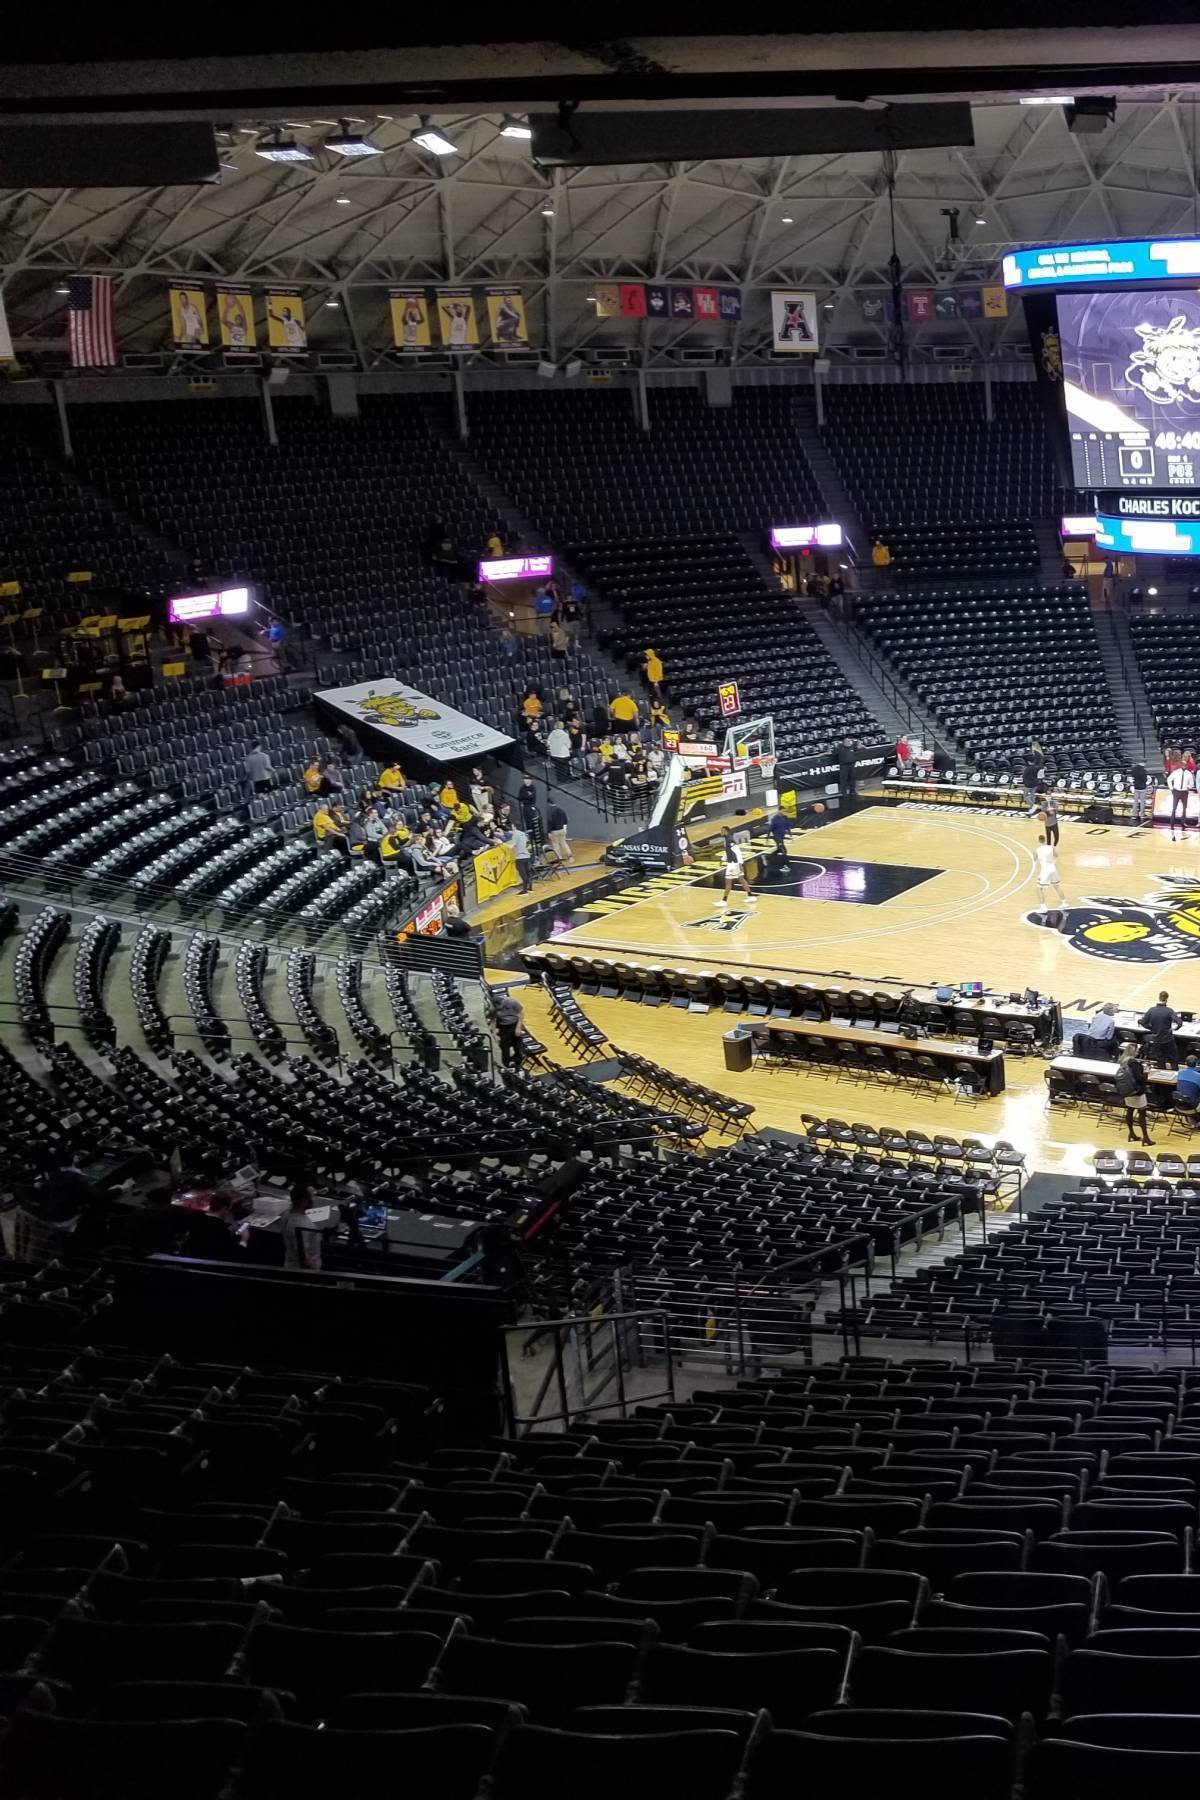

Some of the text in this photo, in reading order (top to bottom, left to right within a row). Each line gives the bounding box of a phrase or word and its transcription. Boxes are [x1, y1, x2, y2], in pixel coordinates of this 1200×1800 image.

[1130, 450, 1143, 469] 0
[1119, 497, 1169, 514] CHARLES
[723, 694, 736, 711] 23
[426, 731, 486, 751] Commerce
[450, 742, 483, 754] Bank
